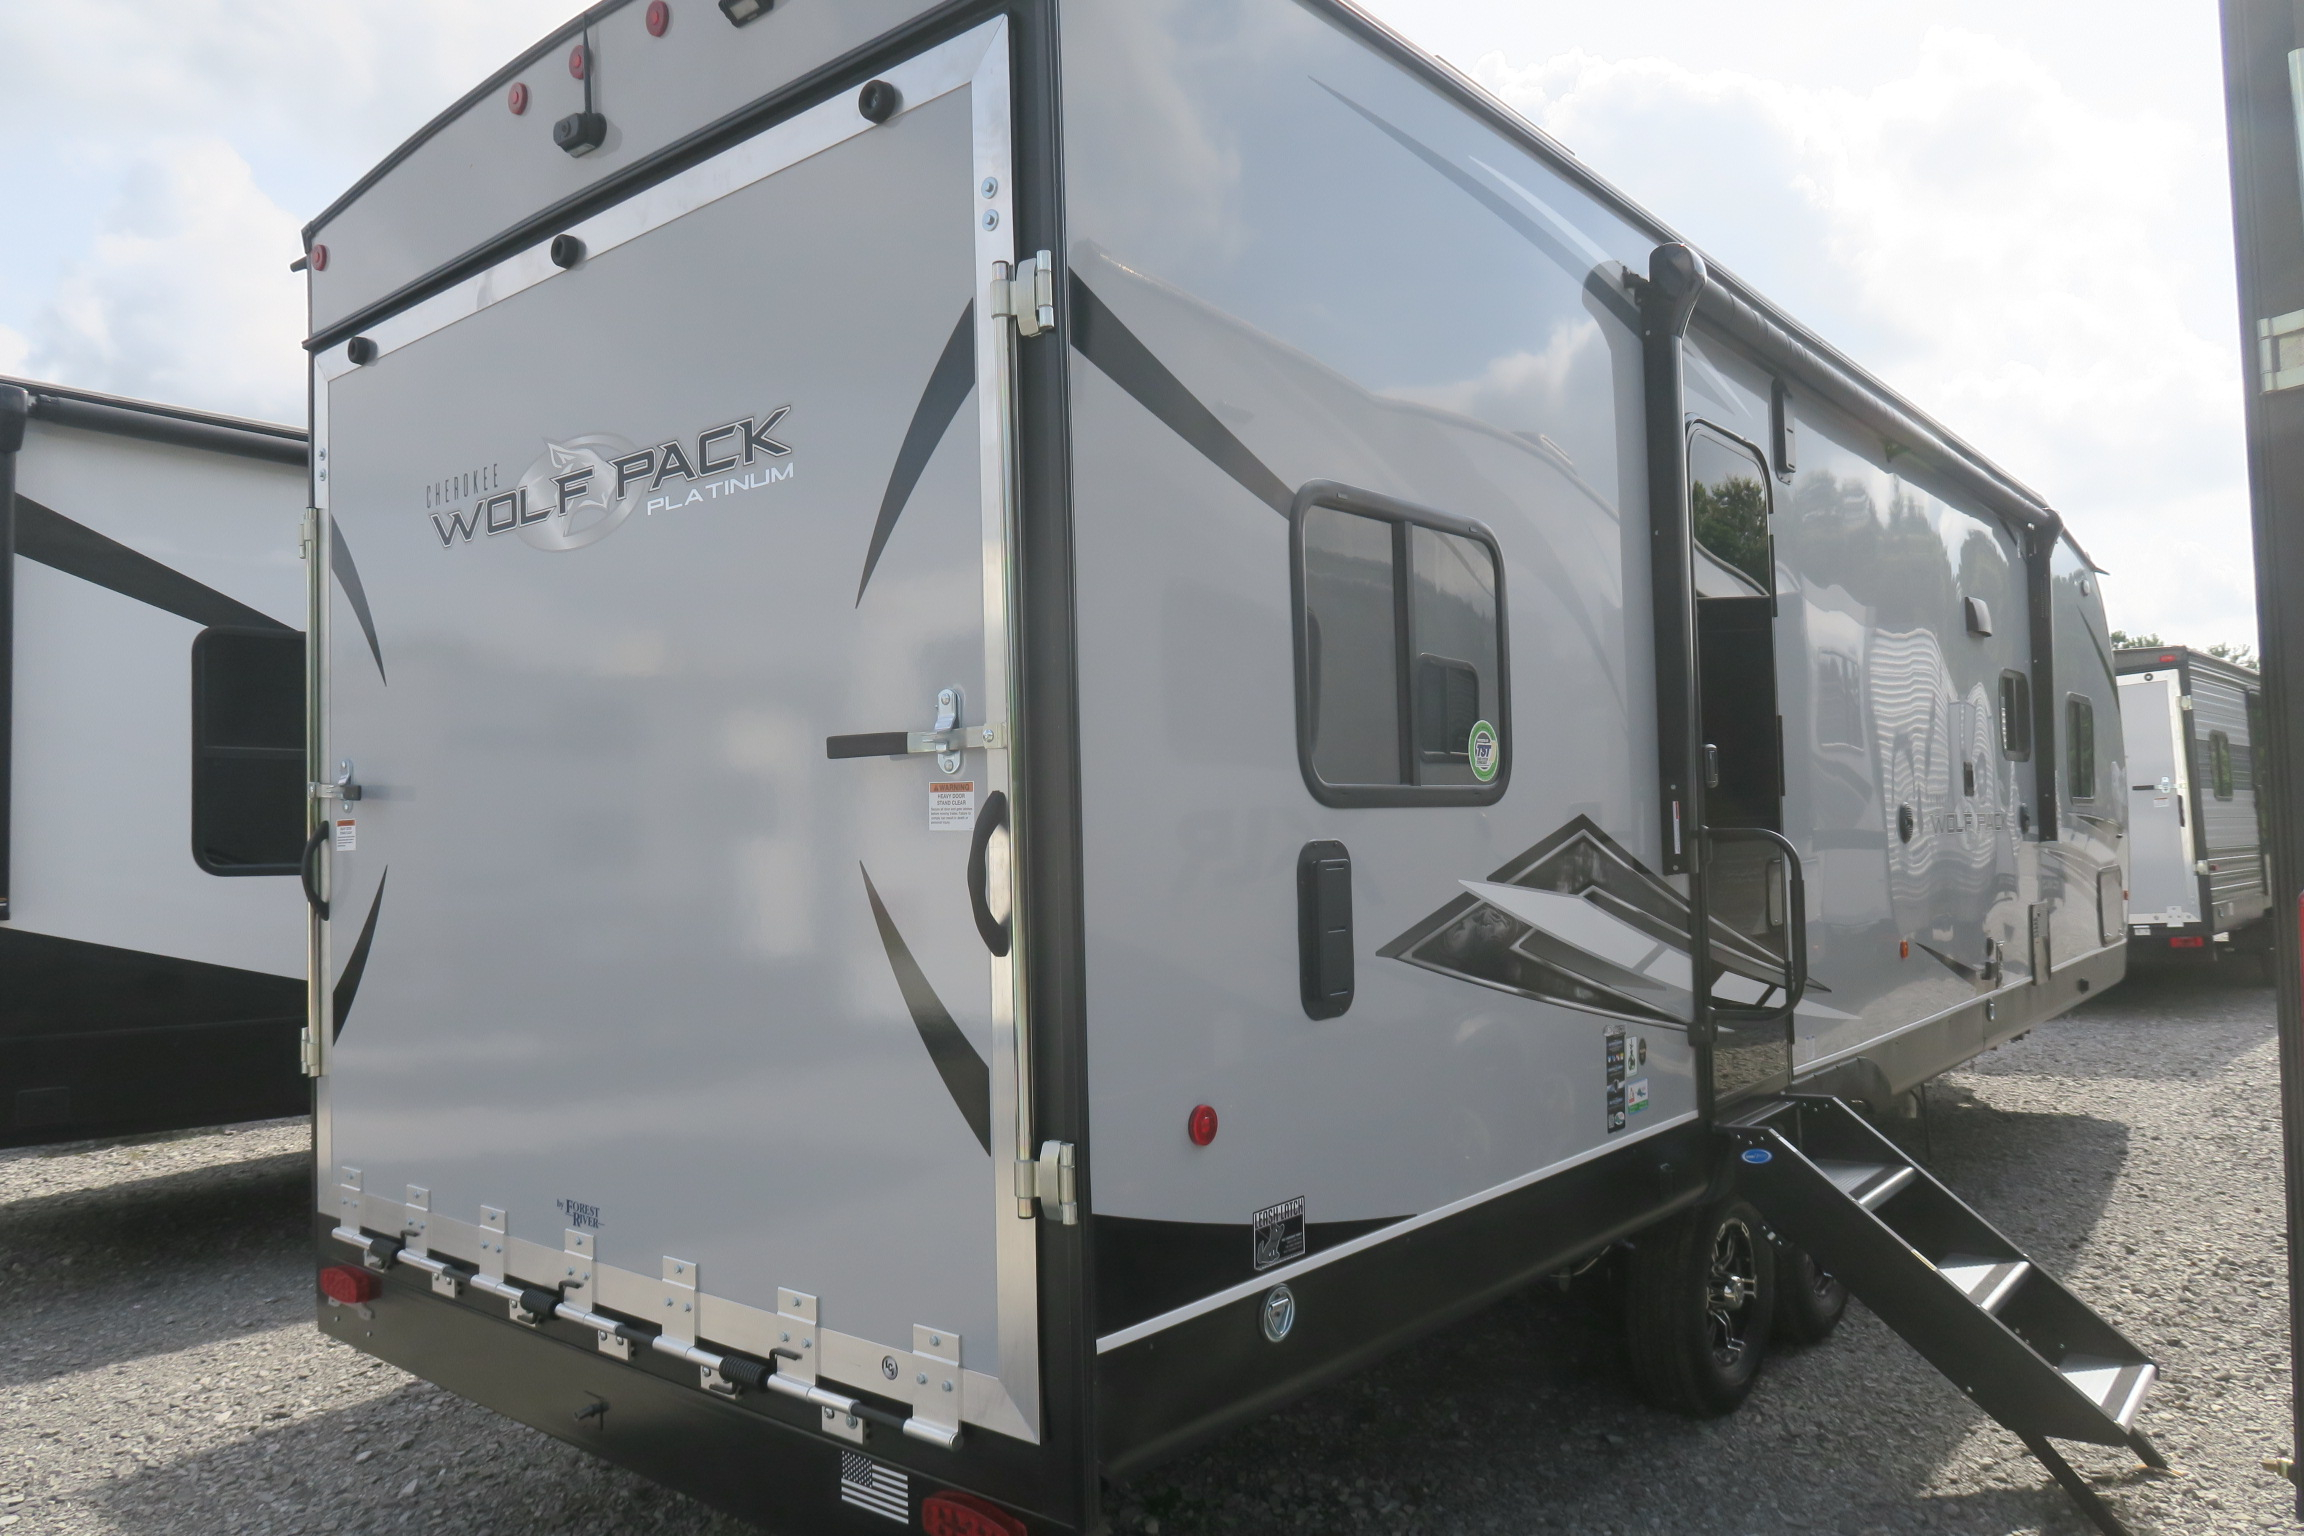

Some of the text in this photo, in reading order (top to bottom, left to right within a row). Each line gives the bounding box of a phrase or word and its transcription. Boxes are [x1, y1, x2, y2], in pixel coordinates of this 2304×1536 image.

[426, 463, 499, 508] CHEROKEE
[430, 404, 792, 548] WOLF PACK
[646, 462, 794, 516] PLATINUM
[1930, 812, 1973, 836] WOLF
[557, 1198, 600, 1218] by FOREST
[573, 1212, 599, 1229] RIVER
